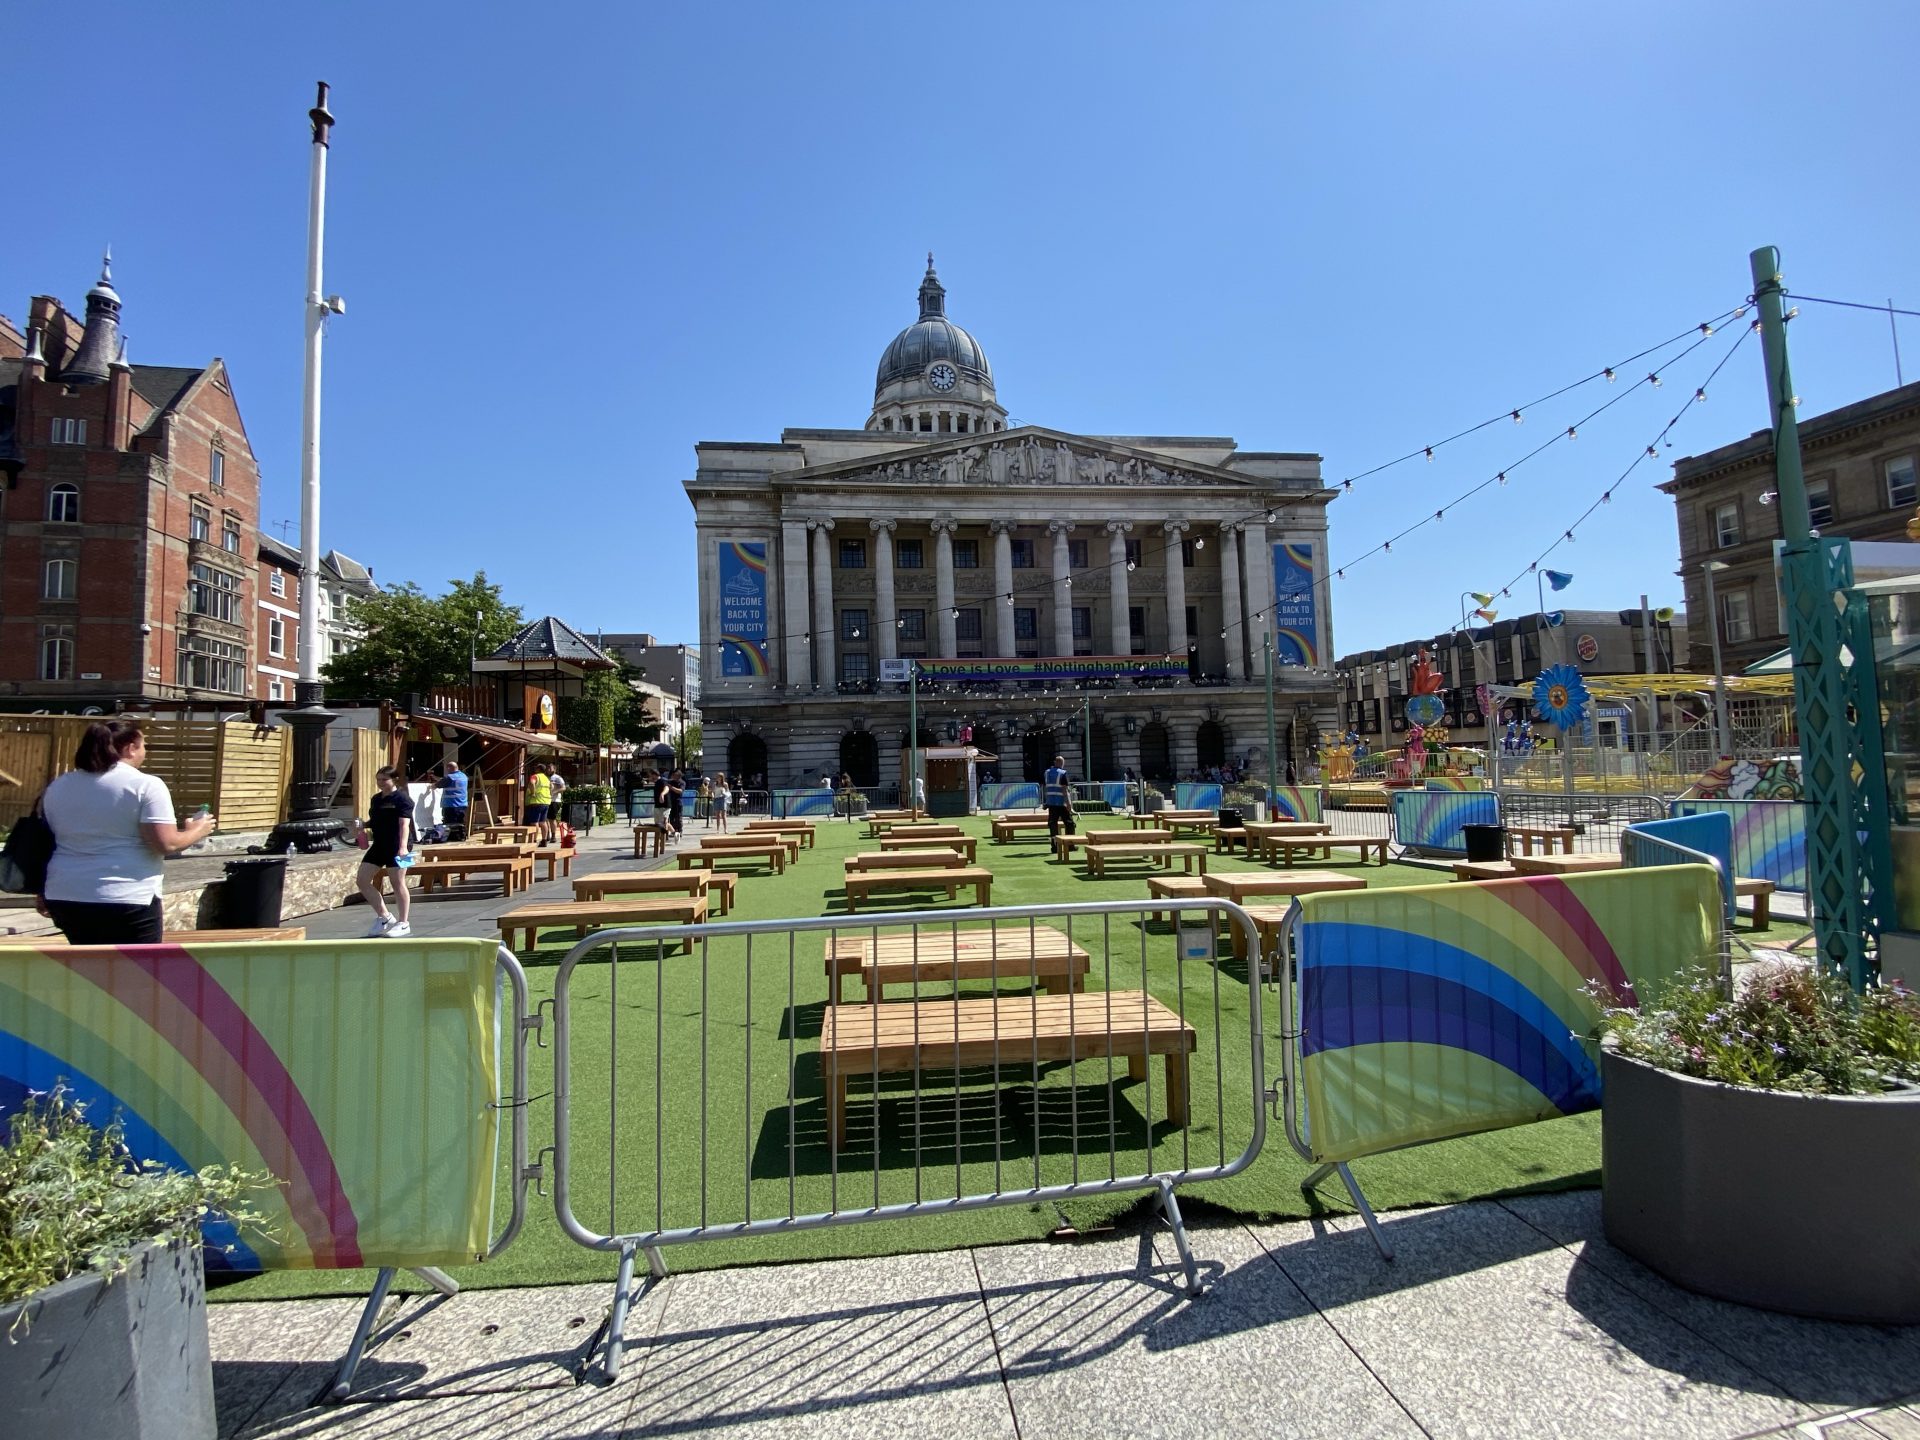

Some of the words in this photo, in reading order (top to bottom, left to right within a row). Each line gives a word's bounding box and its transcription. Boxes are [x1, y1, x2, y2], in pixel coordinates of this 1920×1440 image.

[724, 597, 762, 606] WELCOME
[727, 610, 748, 619] BACK
[750, 610, 760, 619] TO
[1282, 606, 1299, 614] BACK
[1301, 606, 1310, 614] TO
[1280, 617, 1297, 626] YOUR
[1299, 617, 1313, 626] CITY
[724, 623, 745, 632] YOUR
[746, 623, 764, 632] CITY
[932, 664, 966, 675] Love
[971, 664, 982, 674] is
[987, 663, 1021, 674] Love
